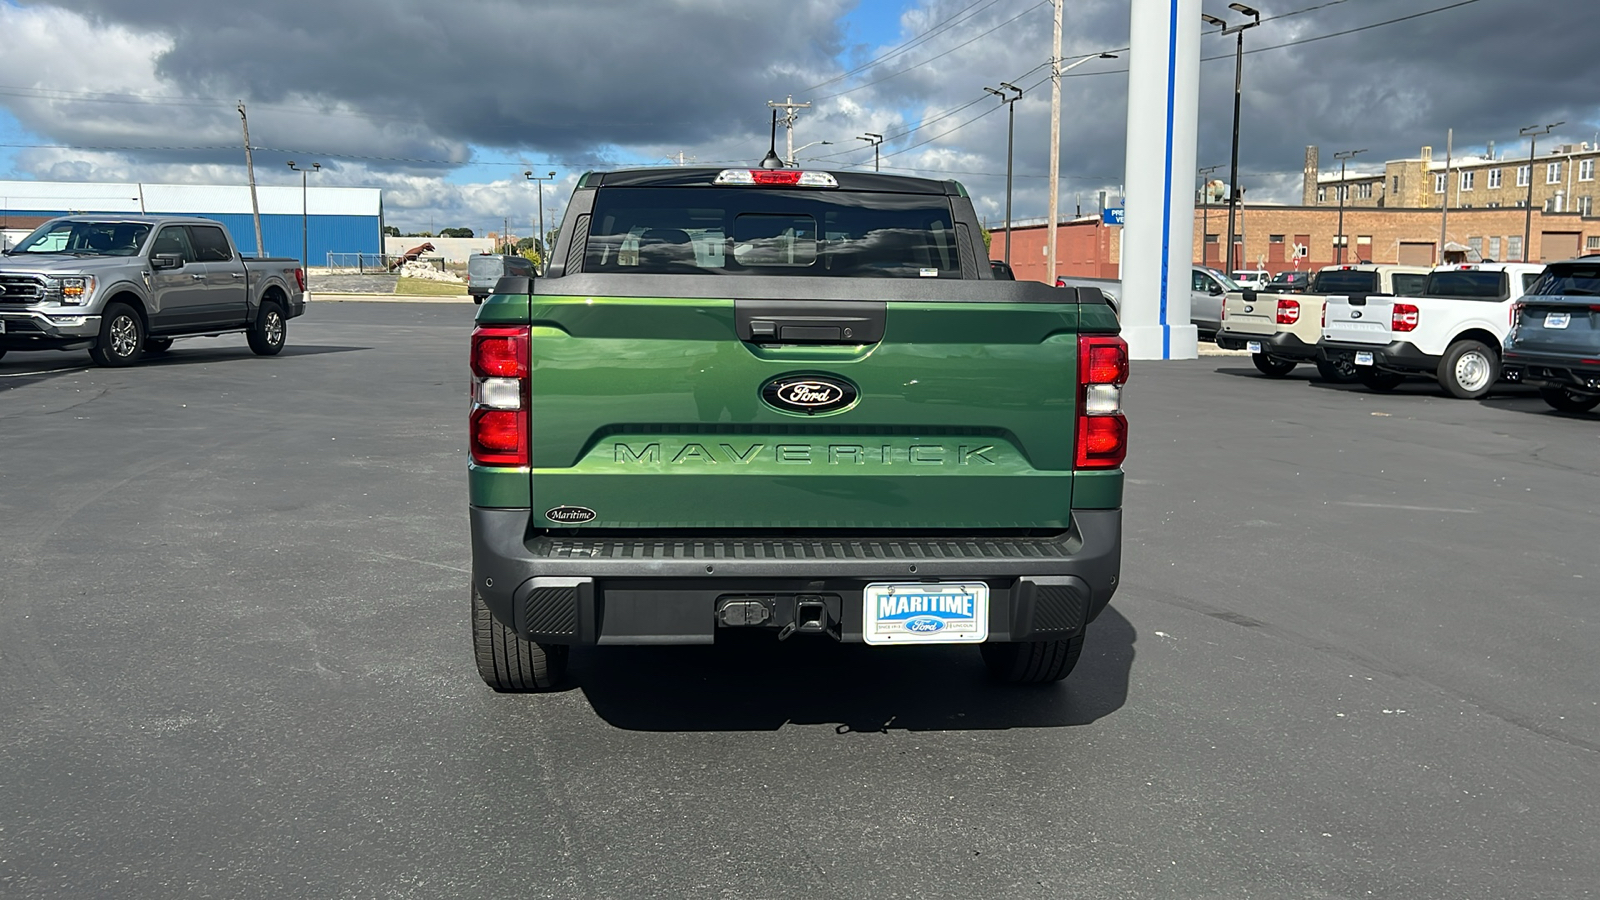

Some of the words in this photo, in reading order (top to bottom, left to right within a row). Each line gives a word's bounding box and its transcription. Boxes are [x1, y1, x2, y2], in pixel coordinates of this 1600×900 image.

[790, 384, 831, 402] Ford
[613, 443, 996, 465] MAVERICK
[551, 510, 591, 519] Maritime
[879, 595, 973, 619] MARITIME
[911, 620, 938, 632] Ford
